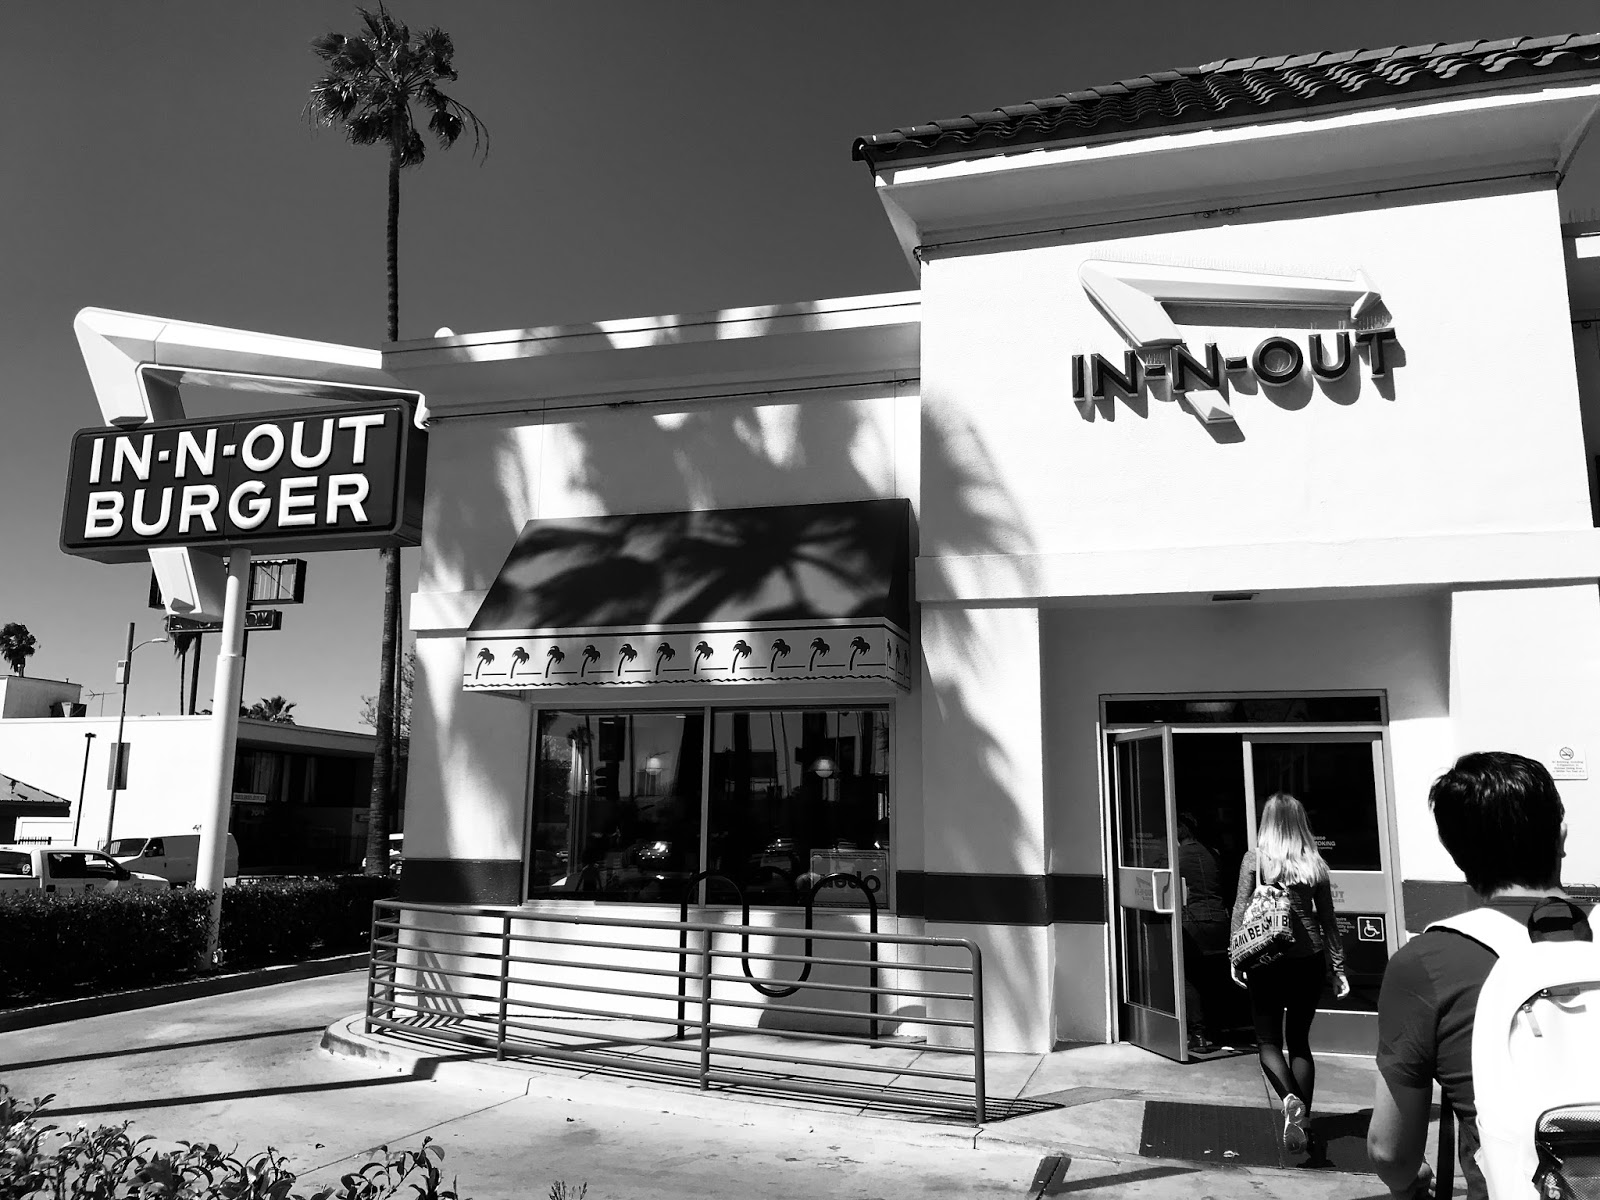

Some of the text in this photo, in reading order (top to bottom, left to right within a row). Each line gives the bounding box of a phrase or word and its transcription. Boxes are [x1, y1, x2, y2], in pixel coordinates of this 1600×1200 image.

[1072, 327, 1397, 402] IN-N-OUT
[89, 413, 385, 483] IN-N-OUT
[83, 473, 370, 538] BURGER
